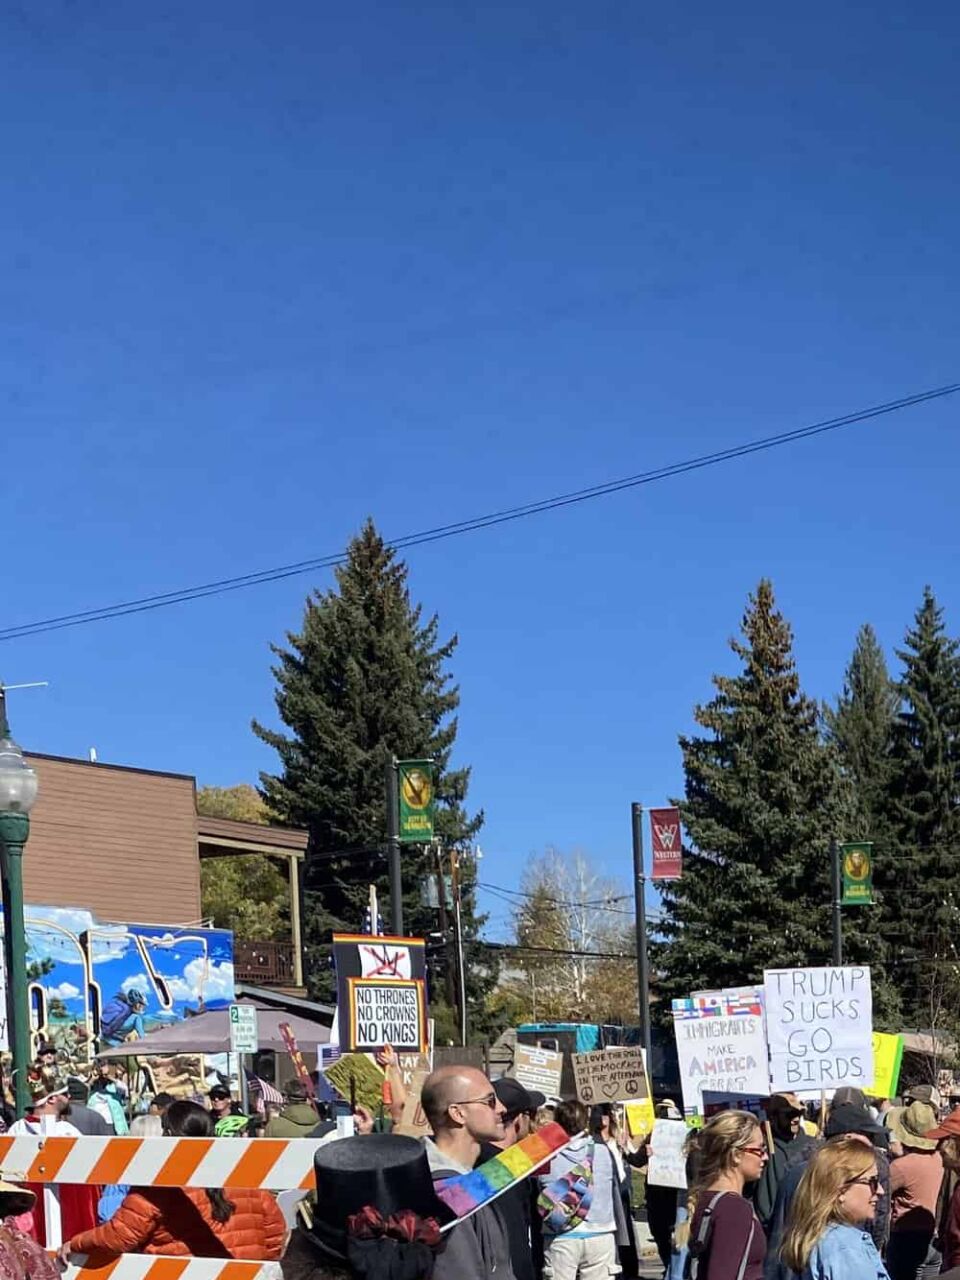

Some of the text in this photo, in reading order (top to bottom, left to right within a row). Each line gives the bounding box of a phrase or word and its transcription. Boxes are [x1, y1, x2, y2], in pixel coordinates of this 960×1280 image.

[768, 968, 865, 997] TRUMP
[357, 989, 416, 1005] NO THRONES
[358, 1006, 416, 1022] NO CROWNS
[781, 999, 860, 1024] SUCKS
[358, 1022, 416, 1043] NO KINGS
[707, 1044, 736, 1057] MAKE
[788, 1027, 832, 1057] GO
[575, 1056, 581, 1065] I
[584, 1053, 606, 1064] LOVE
[607, 1051, 622, 1060] THE
[689, 1056, 757, 1077] AMERICA
[592, 1074, 608, 1082] THE
